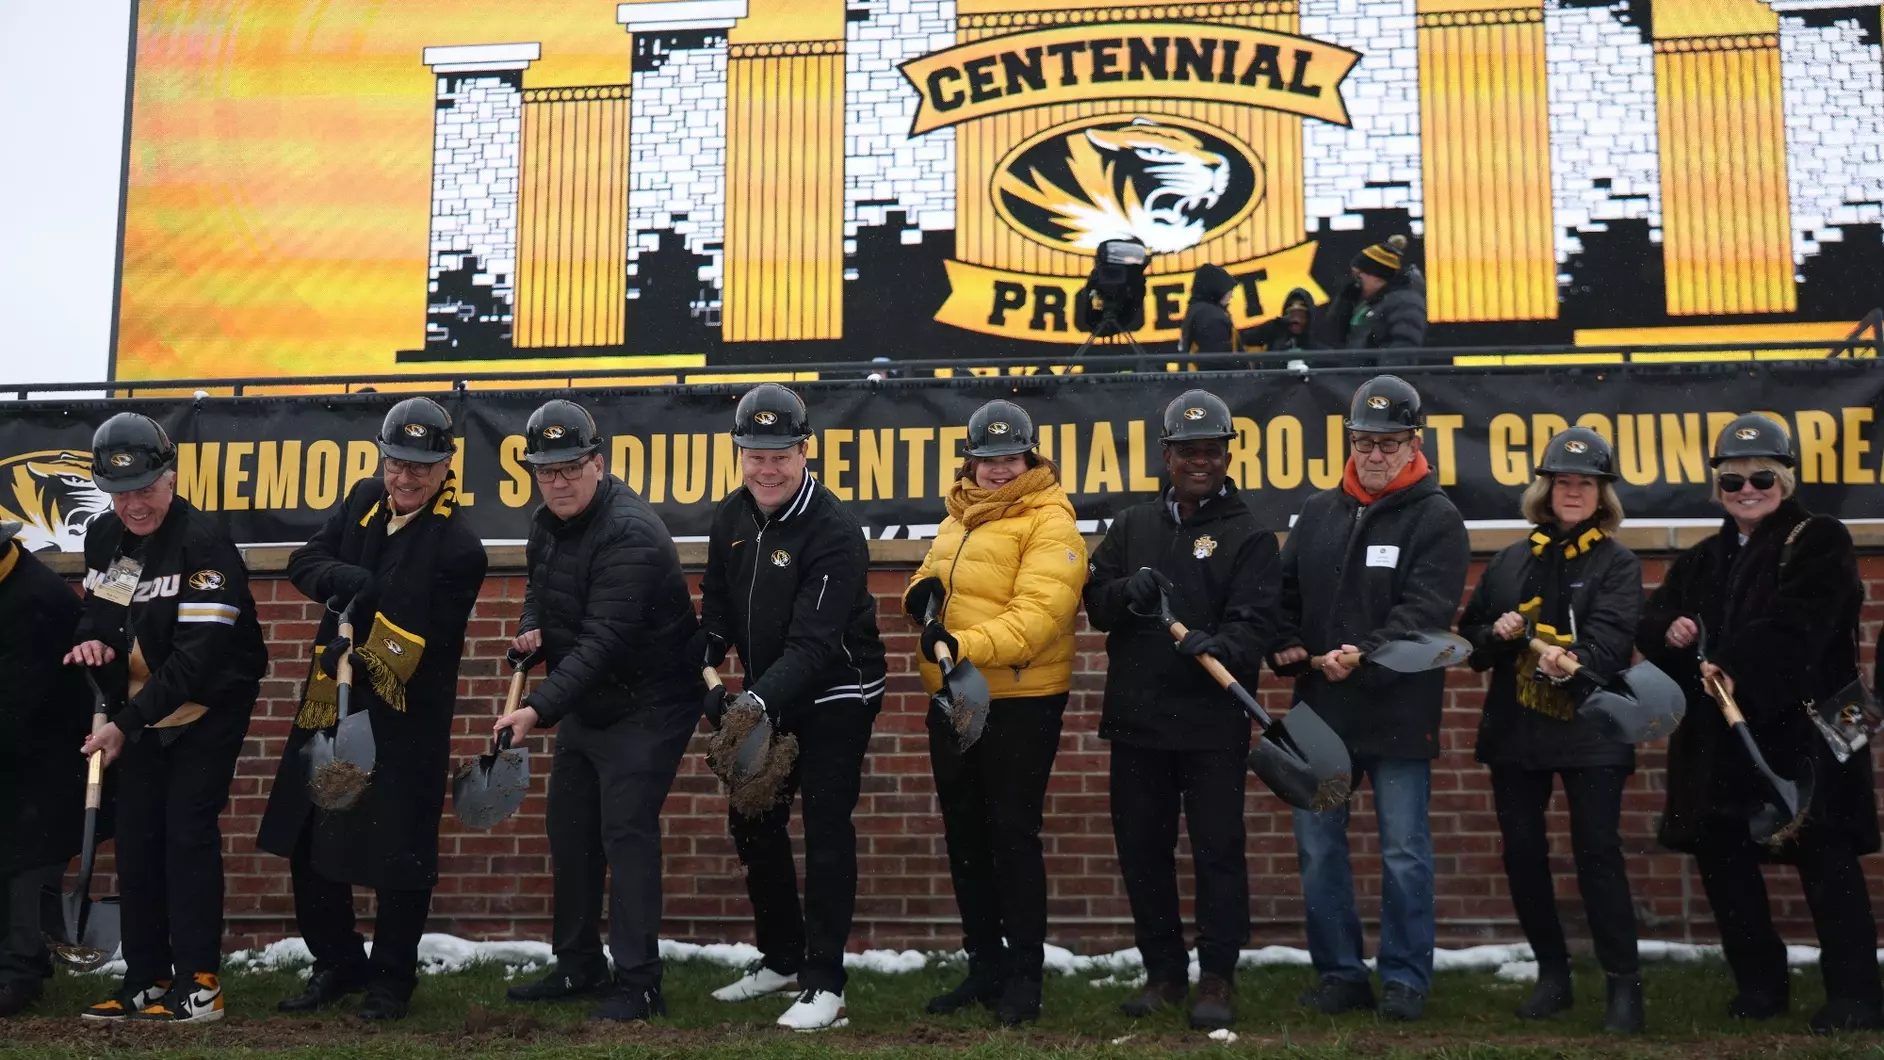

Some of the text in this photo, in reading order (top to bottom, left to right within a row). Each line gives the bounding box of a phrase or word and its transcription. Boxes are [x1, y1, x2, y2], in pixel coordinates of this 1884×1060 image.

[926, 37, 1323, 112] CENTENNIAL
[987, 268, 1268, 333] PRET
[176, 436, 475, 511] MEMORL
[499, 431, 745, 507] SDIUM
[803, 419, 1160, 503] ENTEIAL
[1226, 414, 1465, 489] ROJT
[83, 567, 181, 602] MZOU
